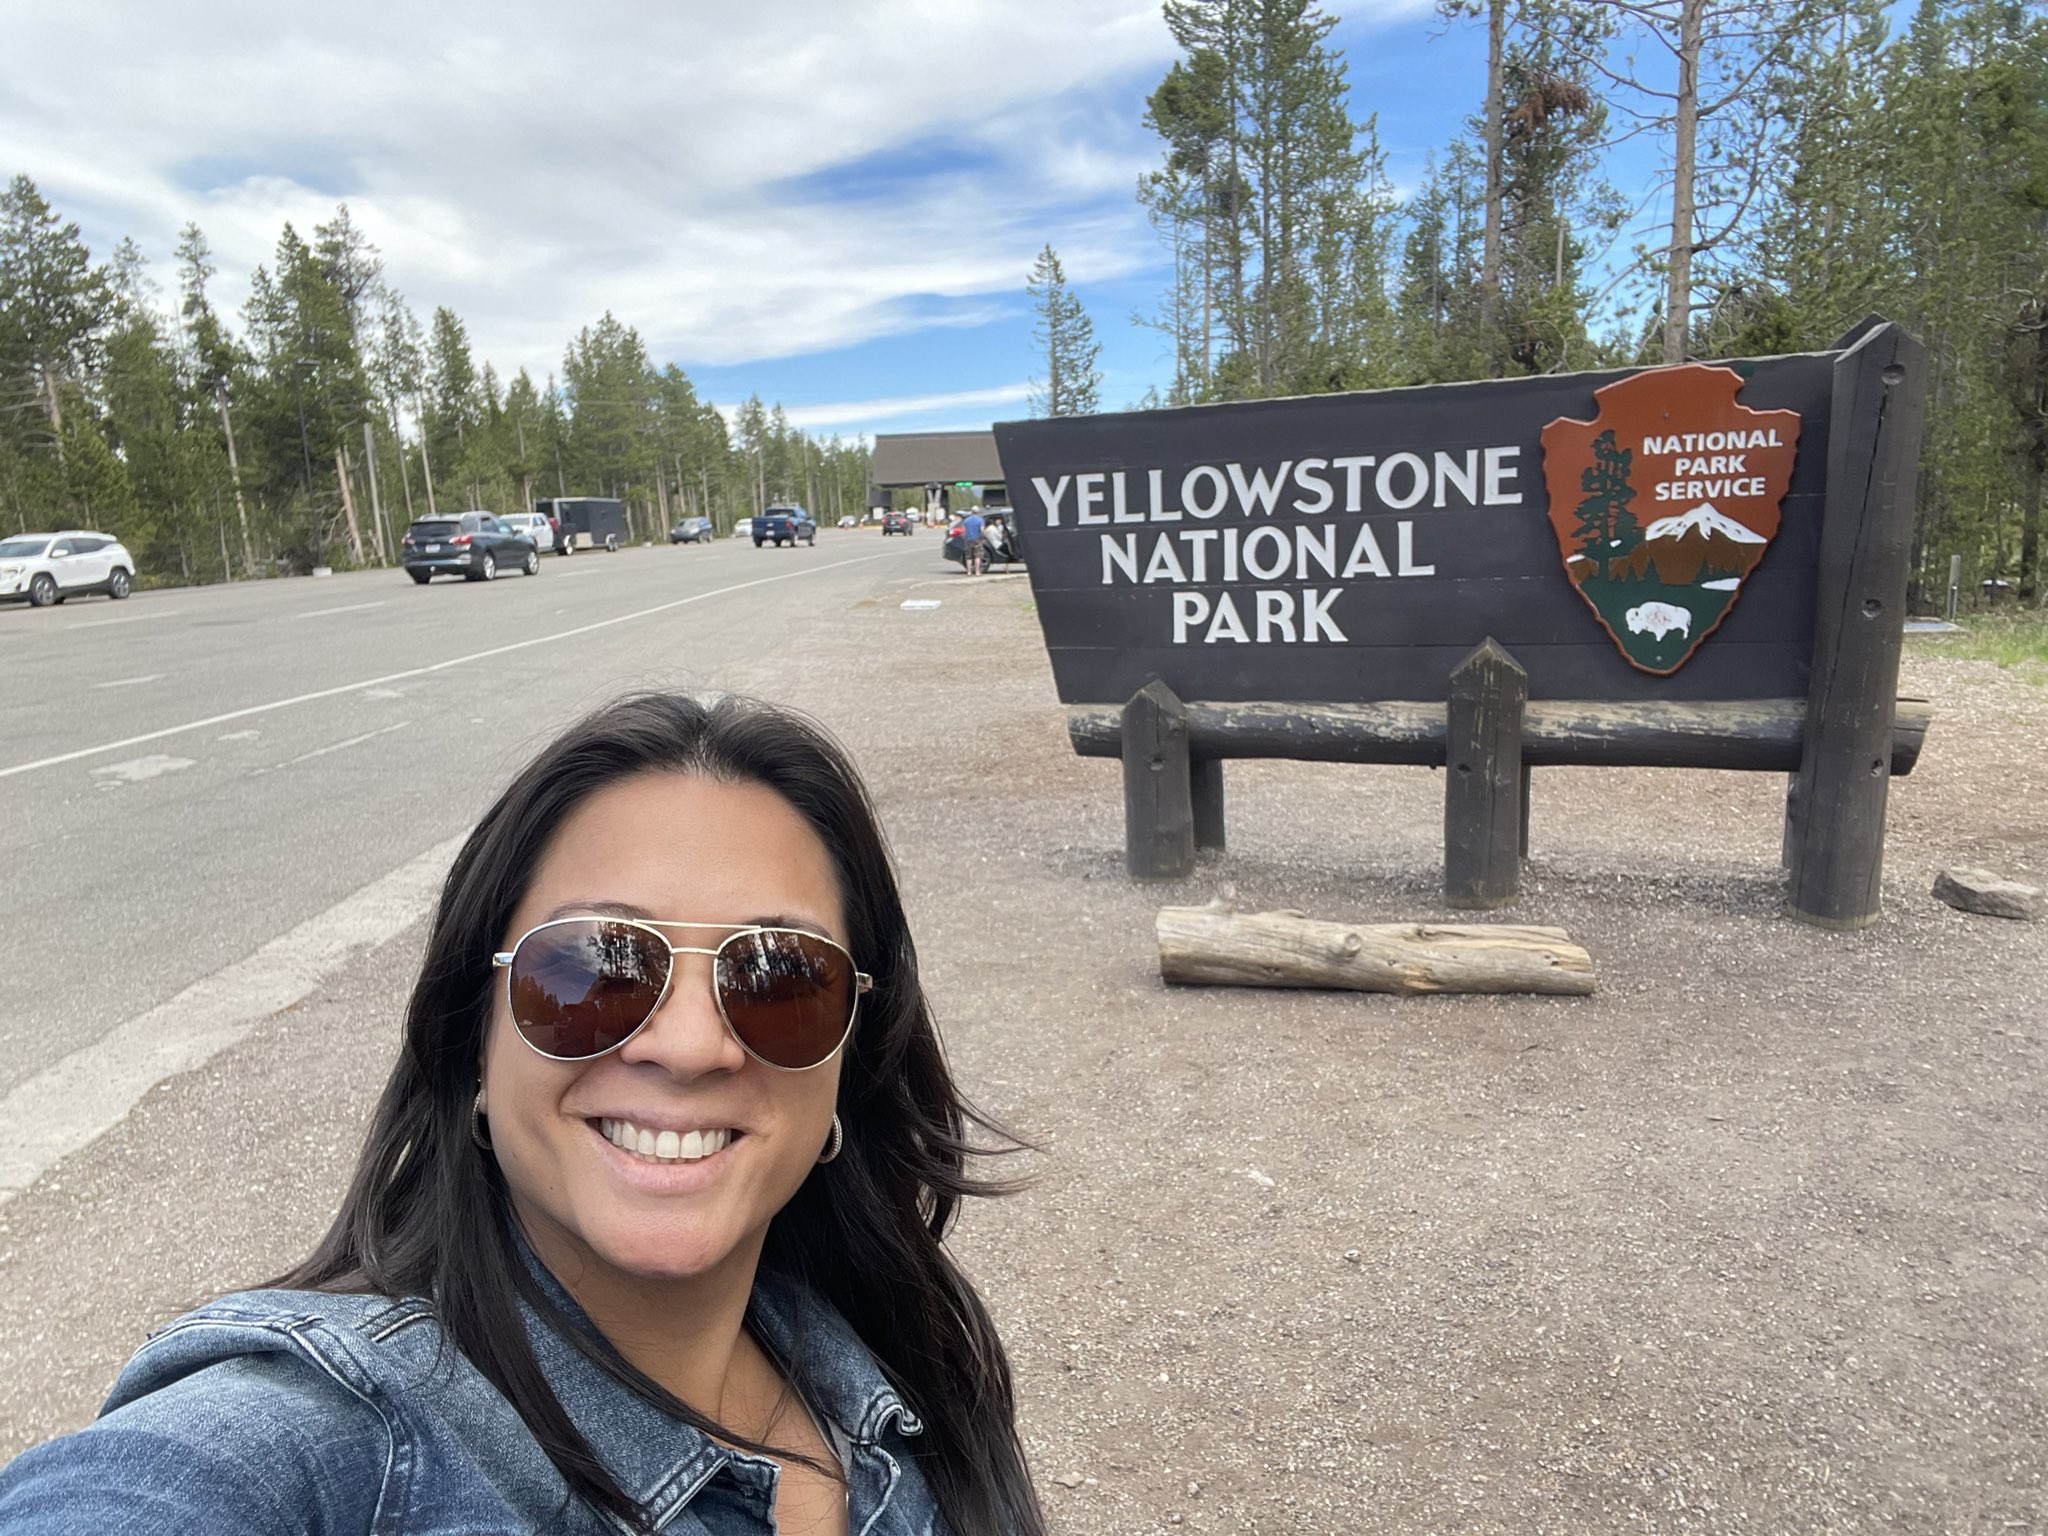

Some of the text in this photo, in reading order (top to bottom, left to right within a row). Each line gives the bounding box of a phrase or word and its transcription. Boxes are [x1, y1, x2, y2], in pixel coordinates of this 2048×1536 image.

[1644, 429, 1782, 455] NATIONAL
[1676, 455, 1746, 476] PARK
[1031, 447, 1522, 526] YELLOWSTONE
[1656, 477, 1765, 500] SERVICE
[1101, 521, 1435, 584] NATIONAL
[1173, 588, 1348, 643] PARK
